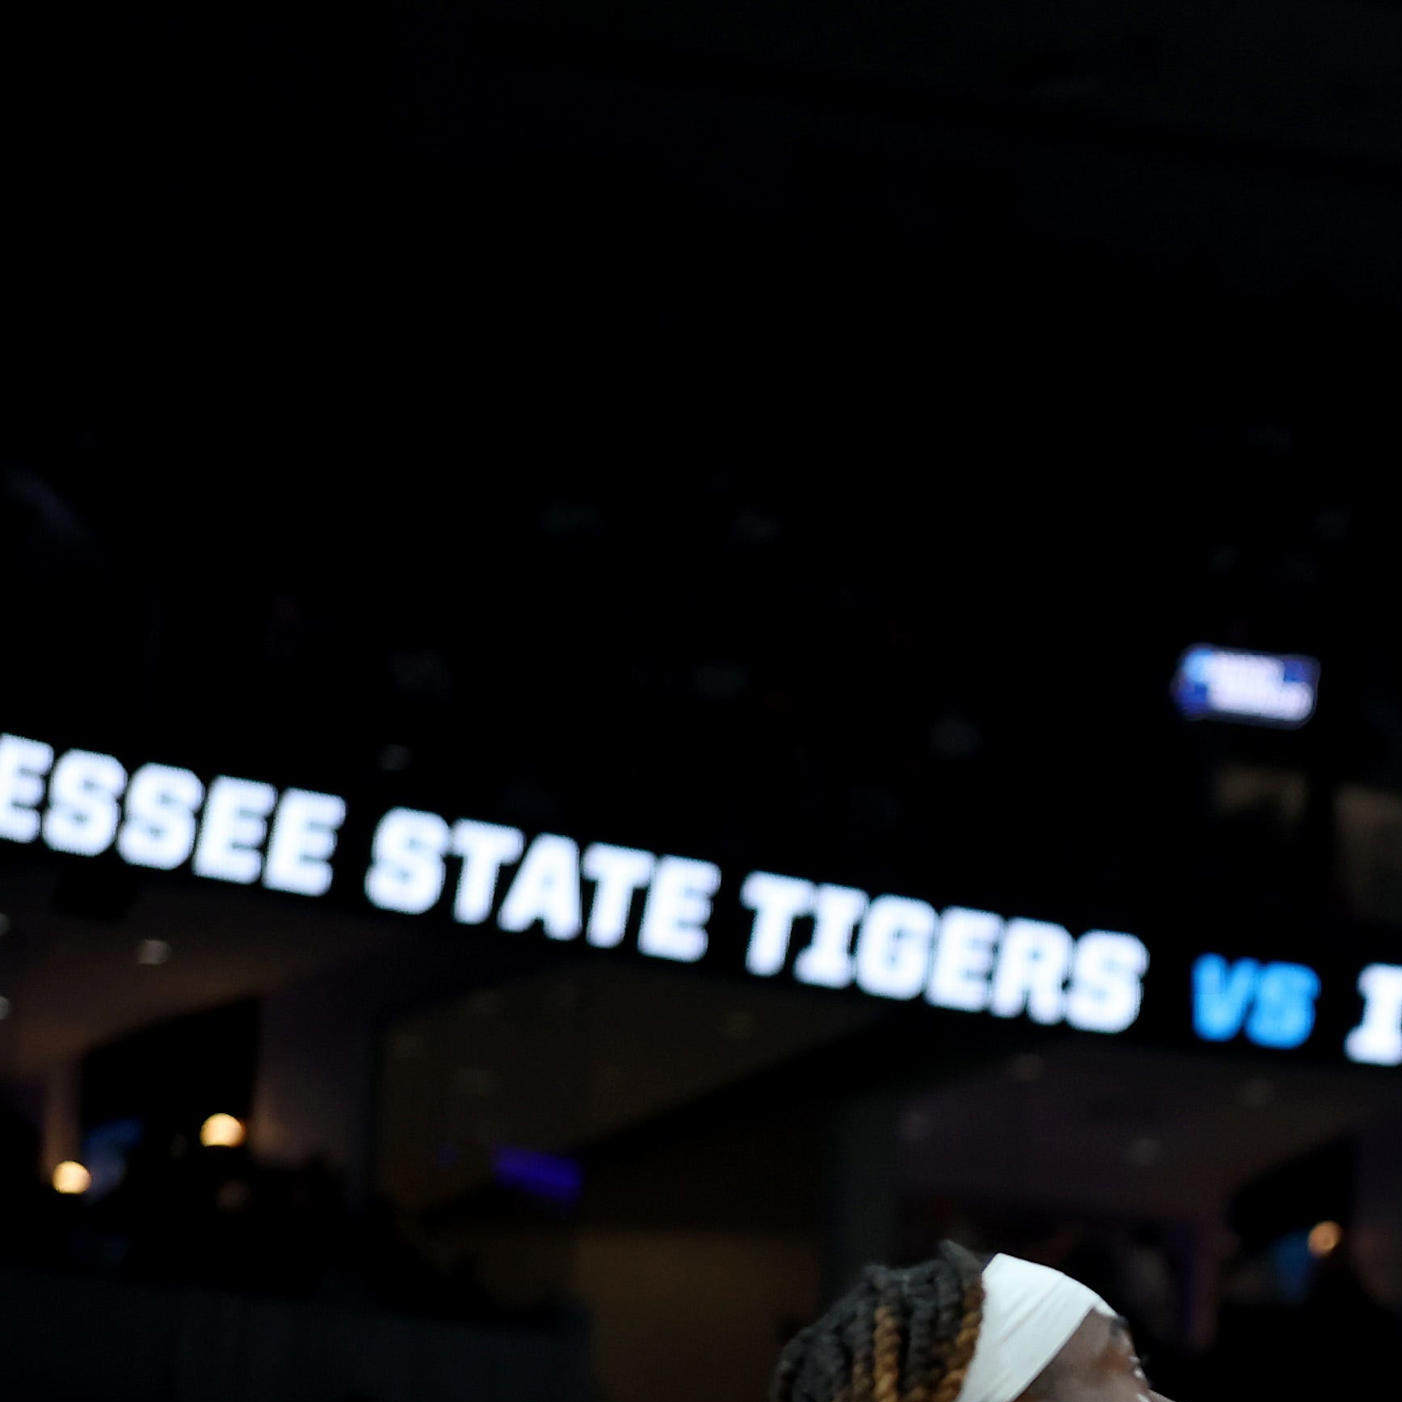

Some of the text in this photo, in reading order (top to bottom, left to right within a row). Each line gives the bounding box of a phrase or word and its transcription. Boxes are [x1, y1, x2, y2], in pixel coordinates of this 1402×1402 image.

[365, 808, 721, 961] STATE
[741, 872, 1149, 1032] TIGERS
[1192, 954, 1320, 1048] VS
